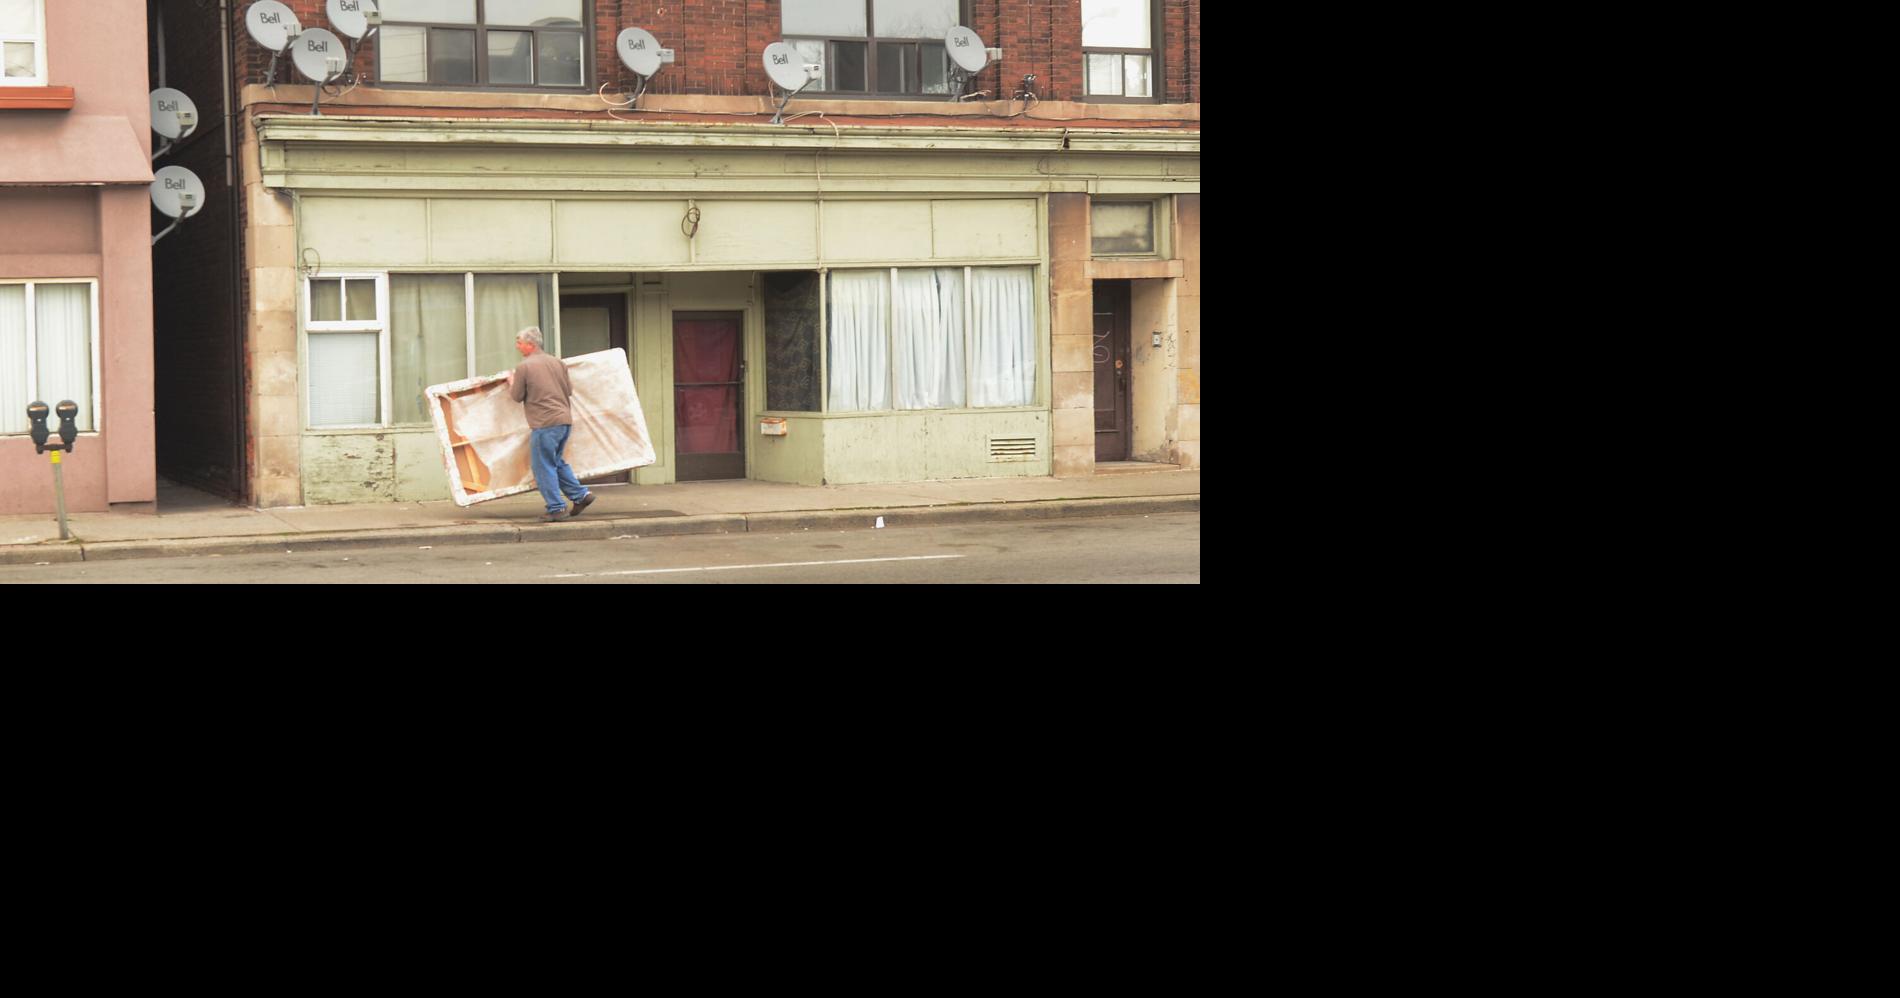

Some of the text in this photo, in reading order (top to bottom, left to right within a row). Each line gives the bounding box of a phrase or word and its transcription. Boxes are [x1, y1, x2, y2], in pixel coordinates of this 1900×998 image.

[340, 0, 360, 11] Bell
[260, 12, 280, 24] Bell
[308, 40, 328, 52] Bell
[628, 39, 645, 50] Bell
[954, 37, 969, 47] Bell
[772, 54, 788, 64] Bell
[157, 100, 178, 111] Bell
[165, 178, 185, 189] Bell
